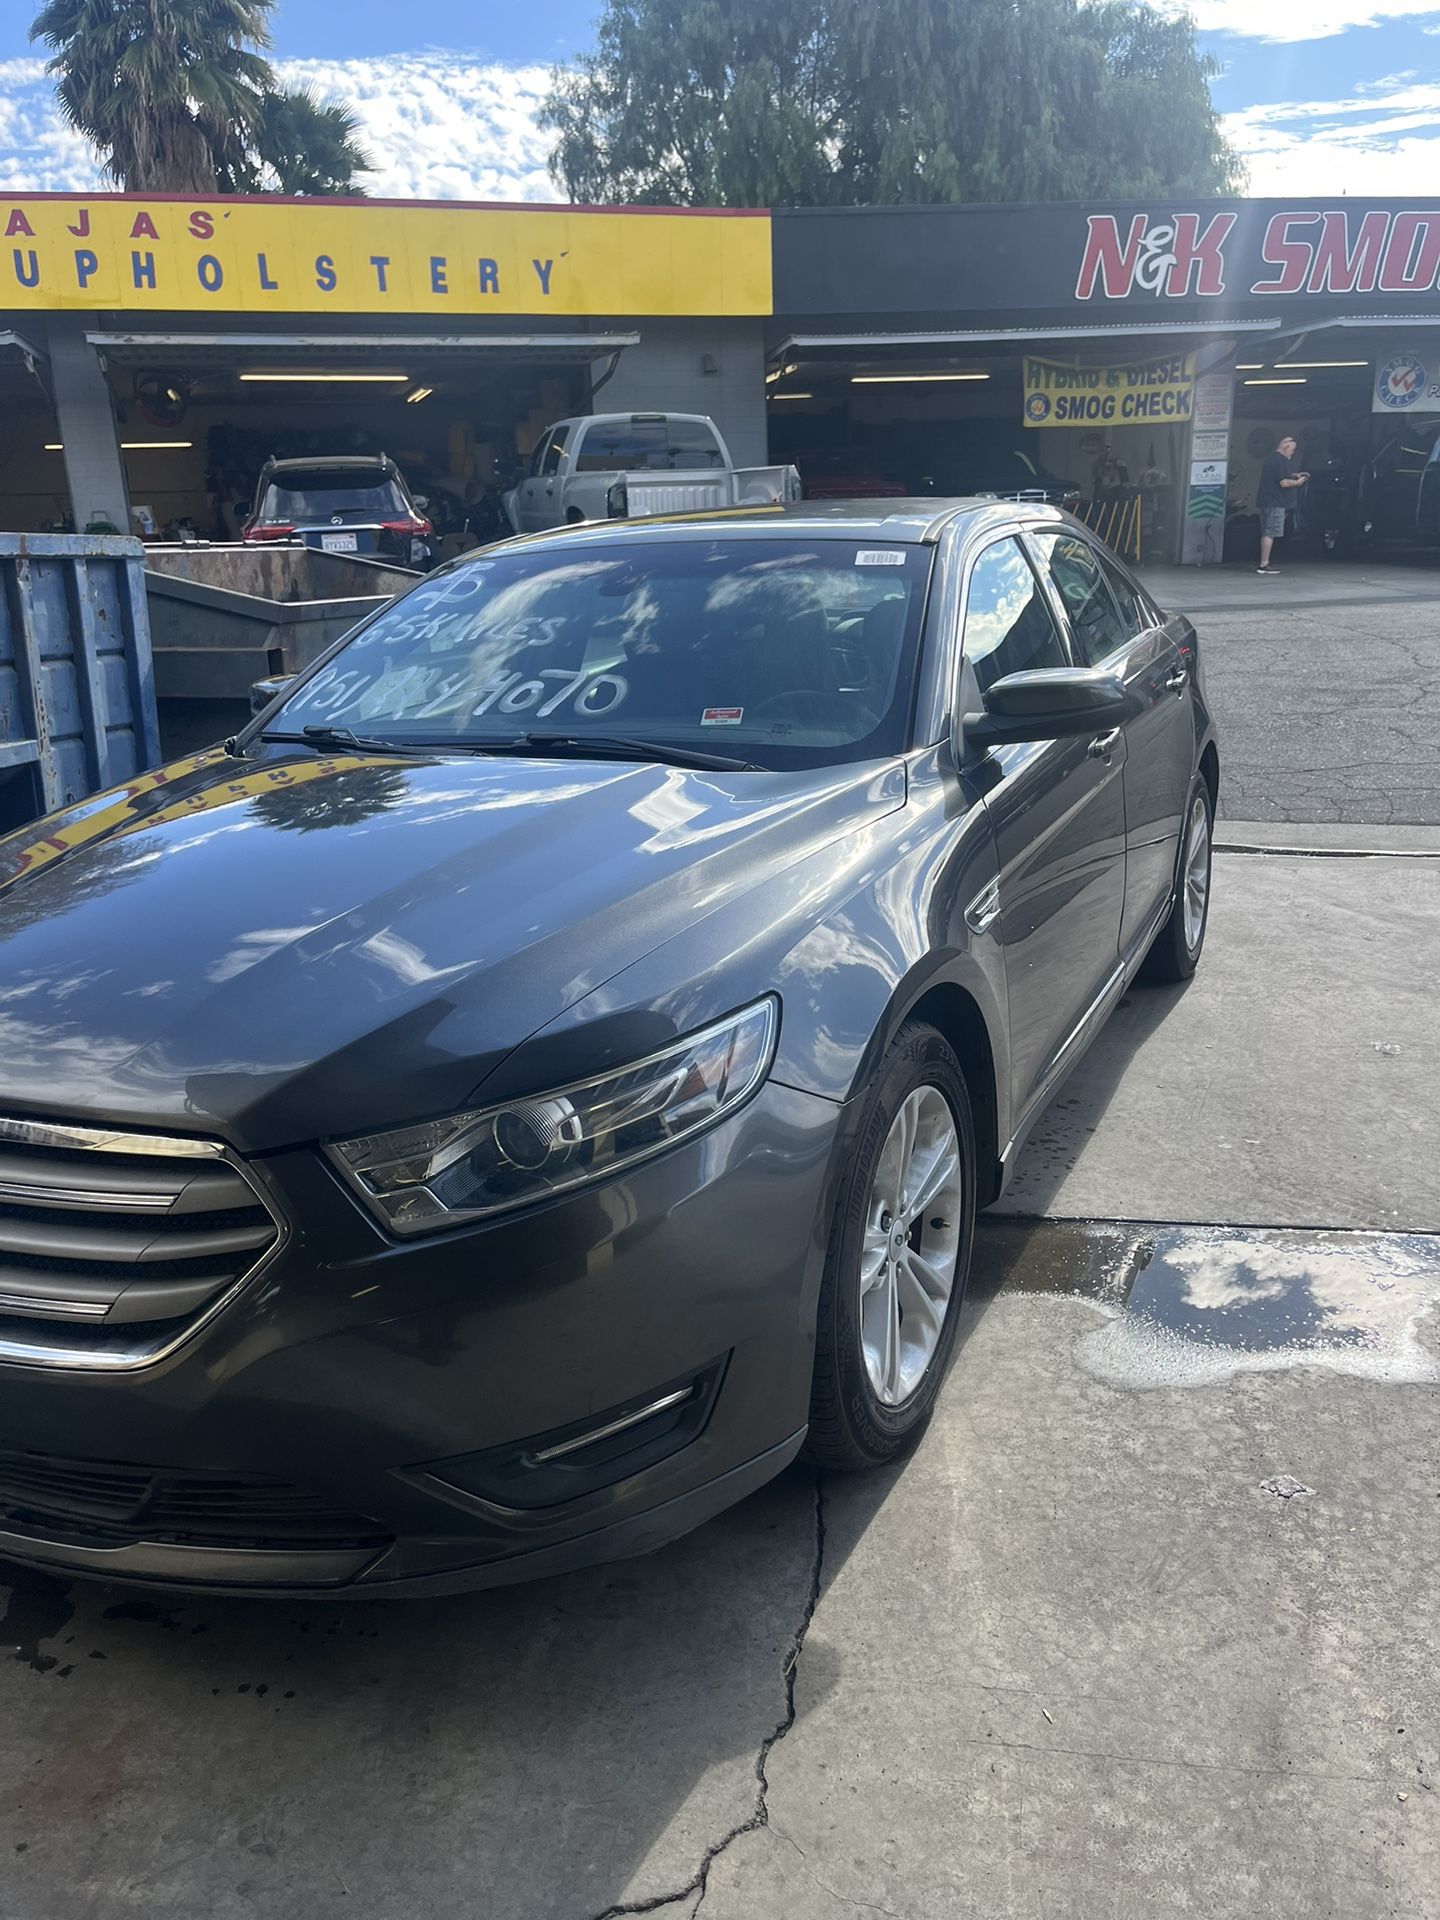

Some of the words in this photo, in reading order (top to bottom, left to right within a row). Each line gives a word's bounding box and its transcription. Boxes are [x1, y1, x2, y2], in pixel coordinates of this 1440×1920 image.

[12, 248, 554, 296] UPHOLSTERY
[1075, 213, 1238, 300] N&K
[1250, 211, 1440, 293] SMO
[1106, 368, 1121, 389] &
[1126, 355, 1192, 386] DIESEL
[1054, 395, 1117, 420] SMOG
[1121, 389, 1193, 418] CHECK
